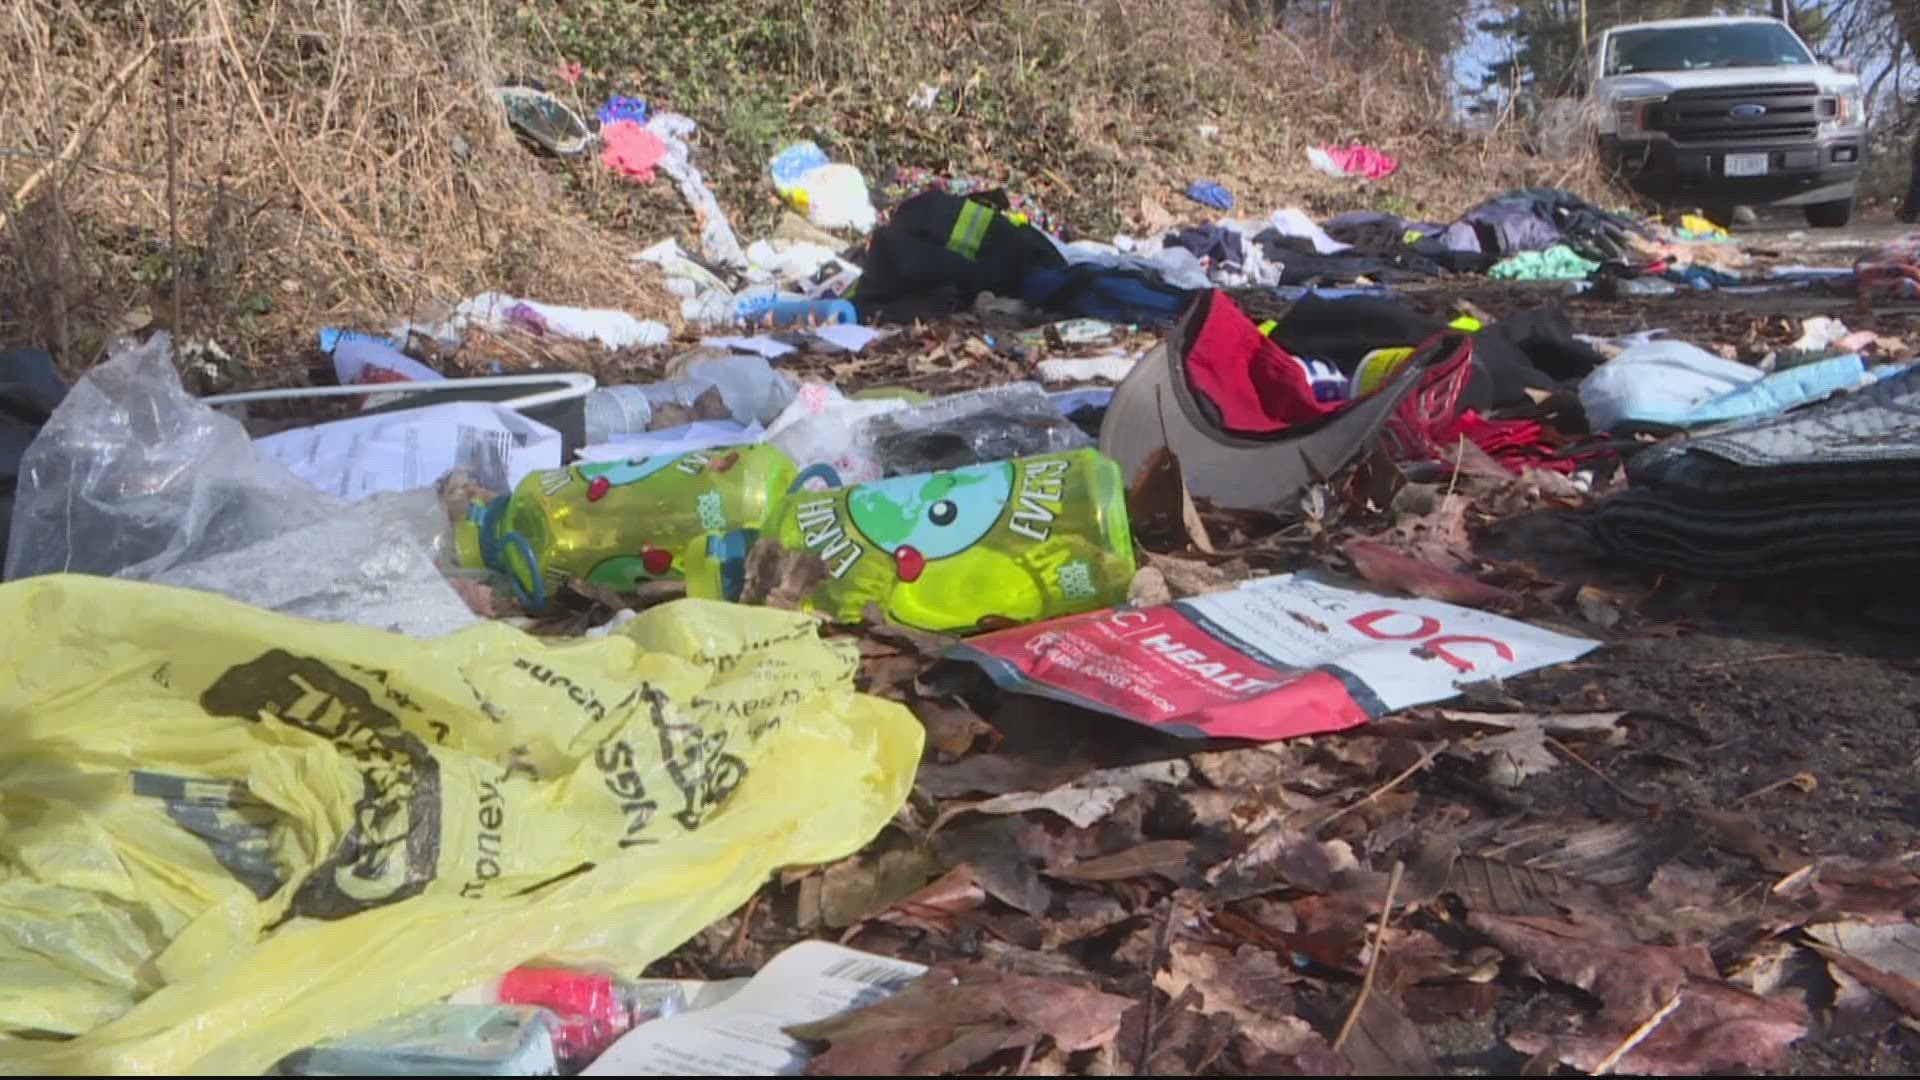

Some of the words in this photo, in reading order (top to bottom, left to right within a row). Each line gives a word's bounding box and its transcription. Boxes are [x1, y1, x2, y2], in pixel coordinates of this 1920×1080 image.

[797, 497, 863, 579] EARTH
[1008, 458, 1071, 542] EVERY
[1140, 632, 1280, 695] HEALT
